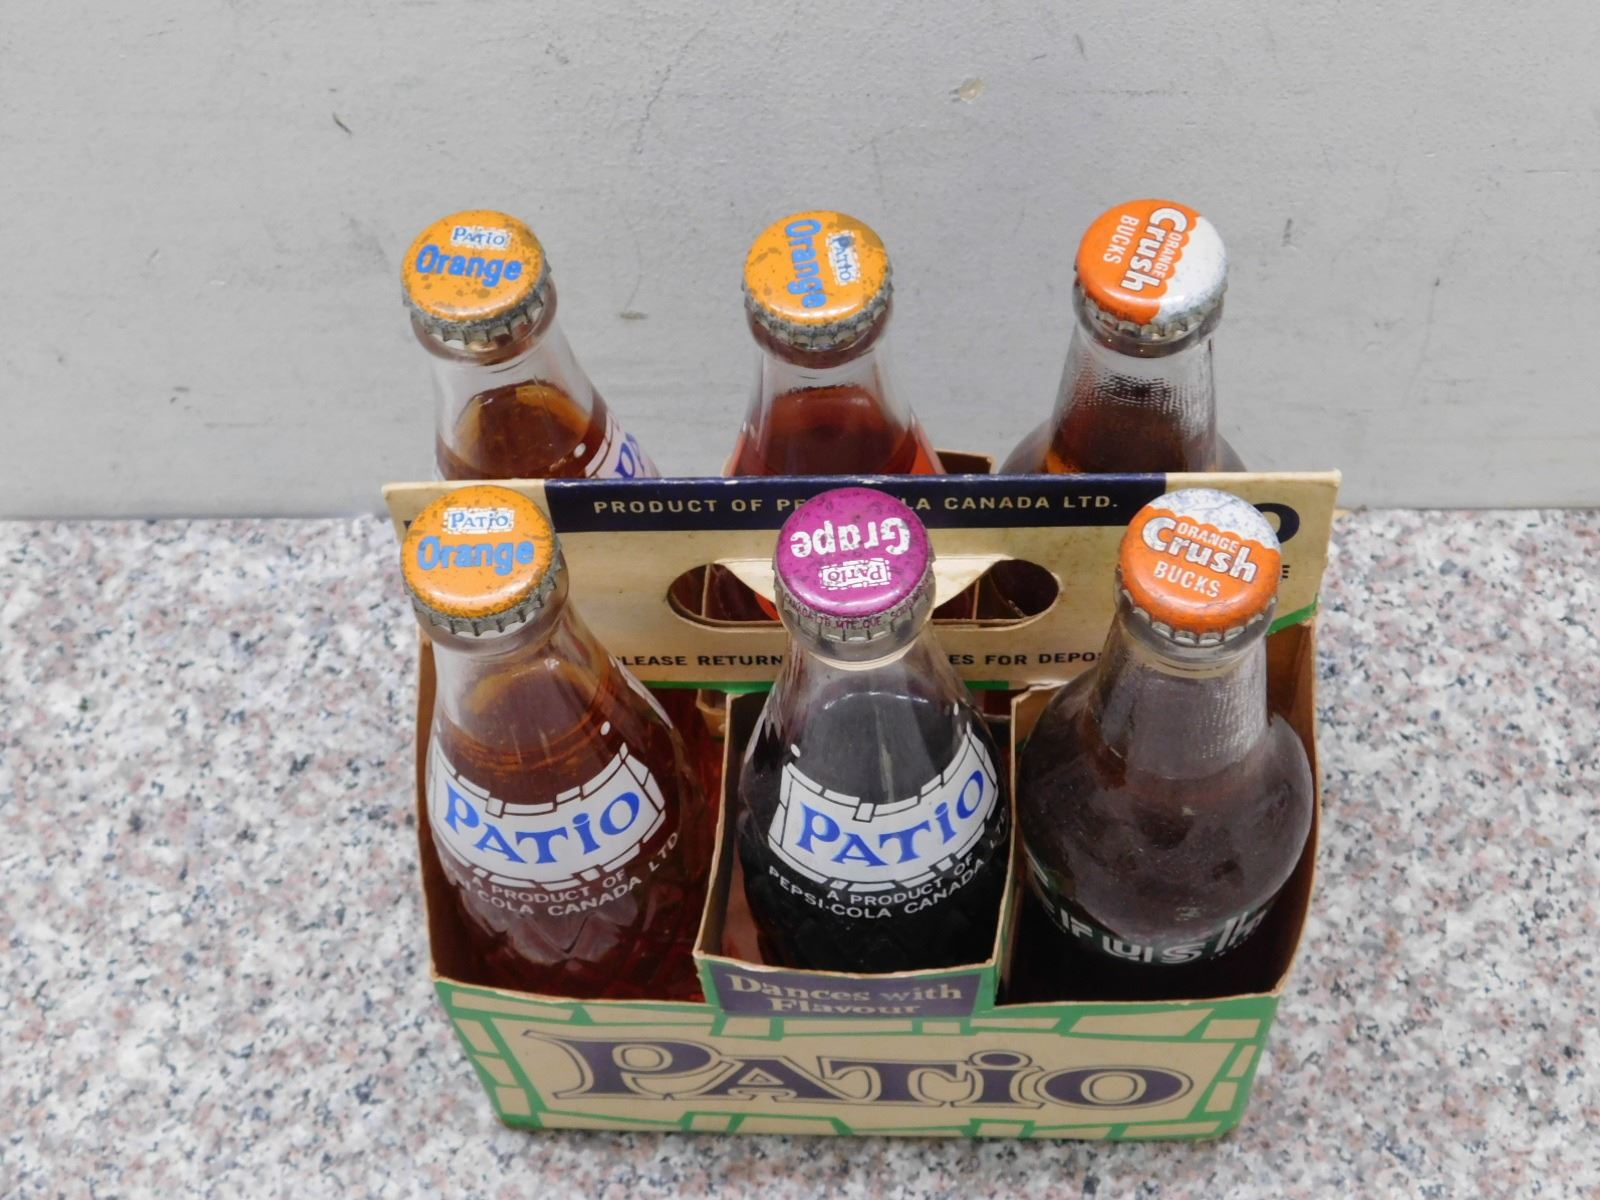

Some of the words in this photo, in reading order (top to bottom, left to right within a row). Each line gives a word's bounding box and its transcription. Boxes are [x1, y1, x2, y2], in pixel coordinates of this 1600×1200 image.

[1102, 214, 1140, 264] BUCKS
[1119, 207, 1188, 292] Crush
[1151, 231, 1184, 279] ORANGE
[416, 243, 523, 288] Orange
[784, 219, 827, 308] Orange
[593, 499, 717, 514] PRODUCT
[731, 498, 763, 512] OF
[943, 496, 1050, 510] CANADA
[1063, 495, 1118, 509] LTD.
[417, 535, 535, 576] Orange
[789, 516, 911, 558] Grape
[1142, 516, 1258, 584] Crush
[1177, 521, 1239, 554] ORANGE
[1154, 560, 1221, 598] BUCKS
[615, 655, 687, 666] LEASE
[697, 655, 784, 666] RETURN
[984, 654, 1028, 666] FOR
[1038, 652, 1102, 665] DEPO
[472, 875, 484, 889] A
[491, 885, 590, 903] PRODUCT
[602, 867, 626, 889] OF
[547, 876, 643, 917] CANADA
[768, 865, 893, 919] PEPSI-COLA
[904, 858, 985, 914] CANADA
[826, 888, 841, 901] A
[850, 877, 944, 906] PRODUCT
[953, 852, 974, 877] OF
[726, 973, 870, 1002] Dances
[880, 983, 962, 1002] with
[770, 998, 921, 1015] Flavour
